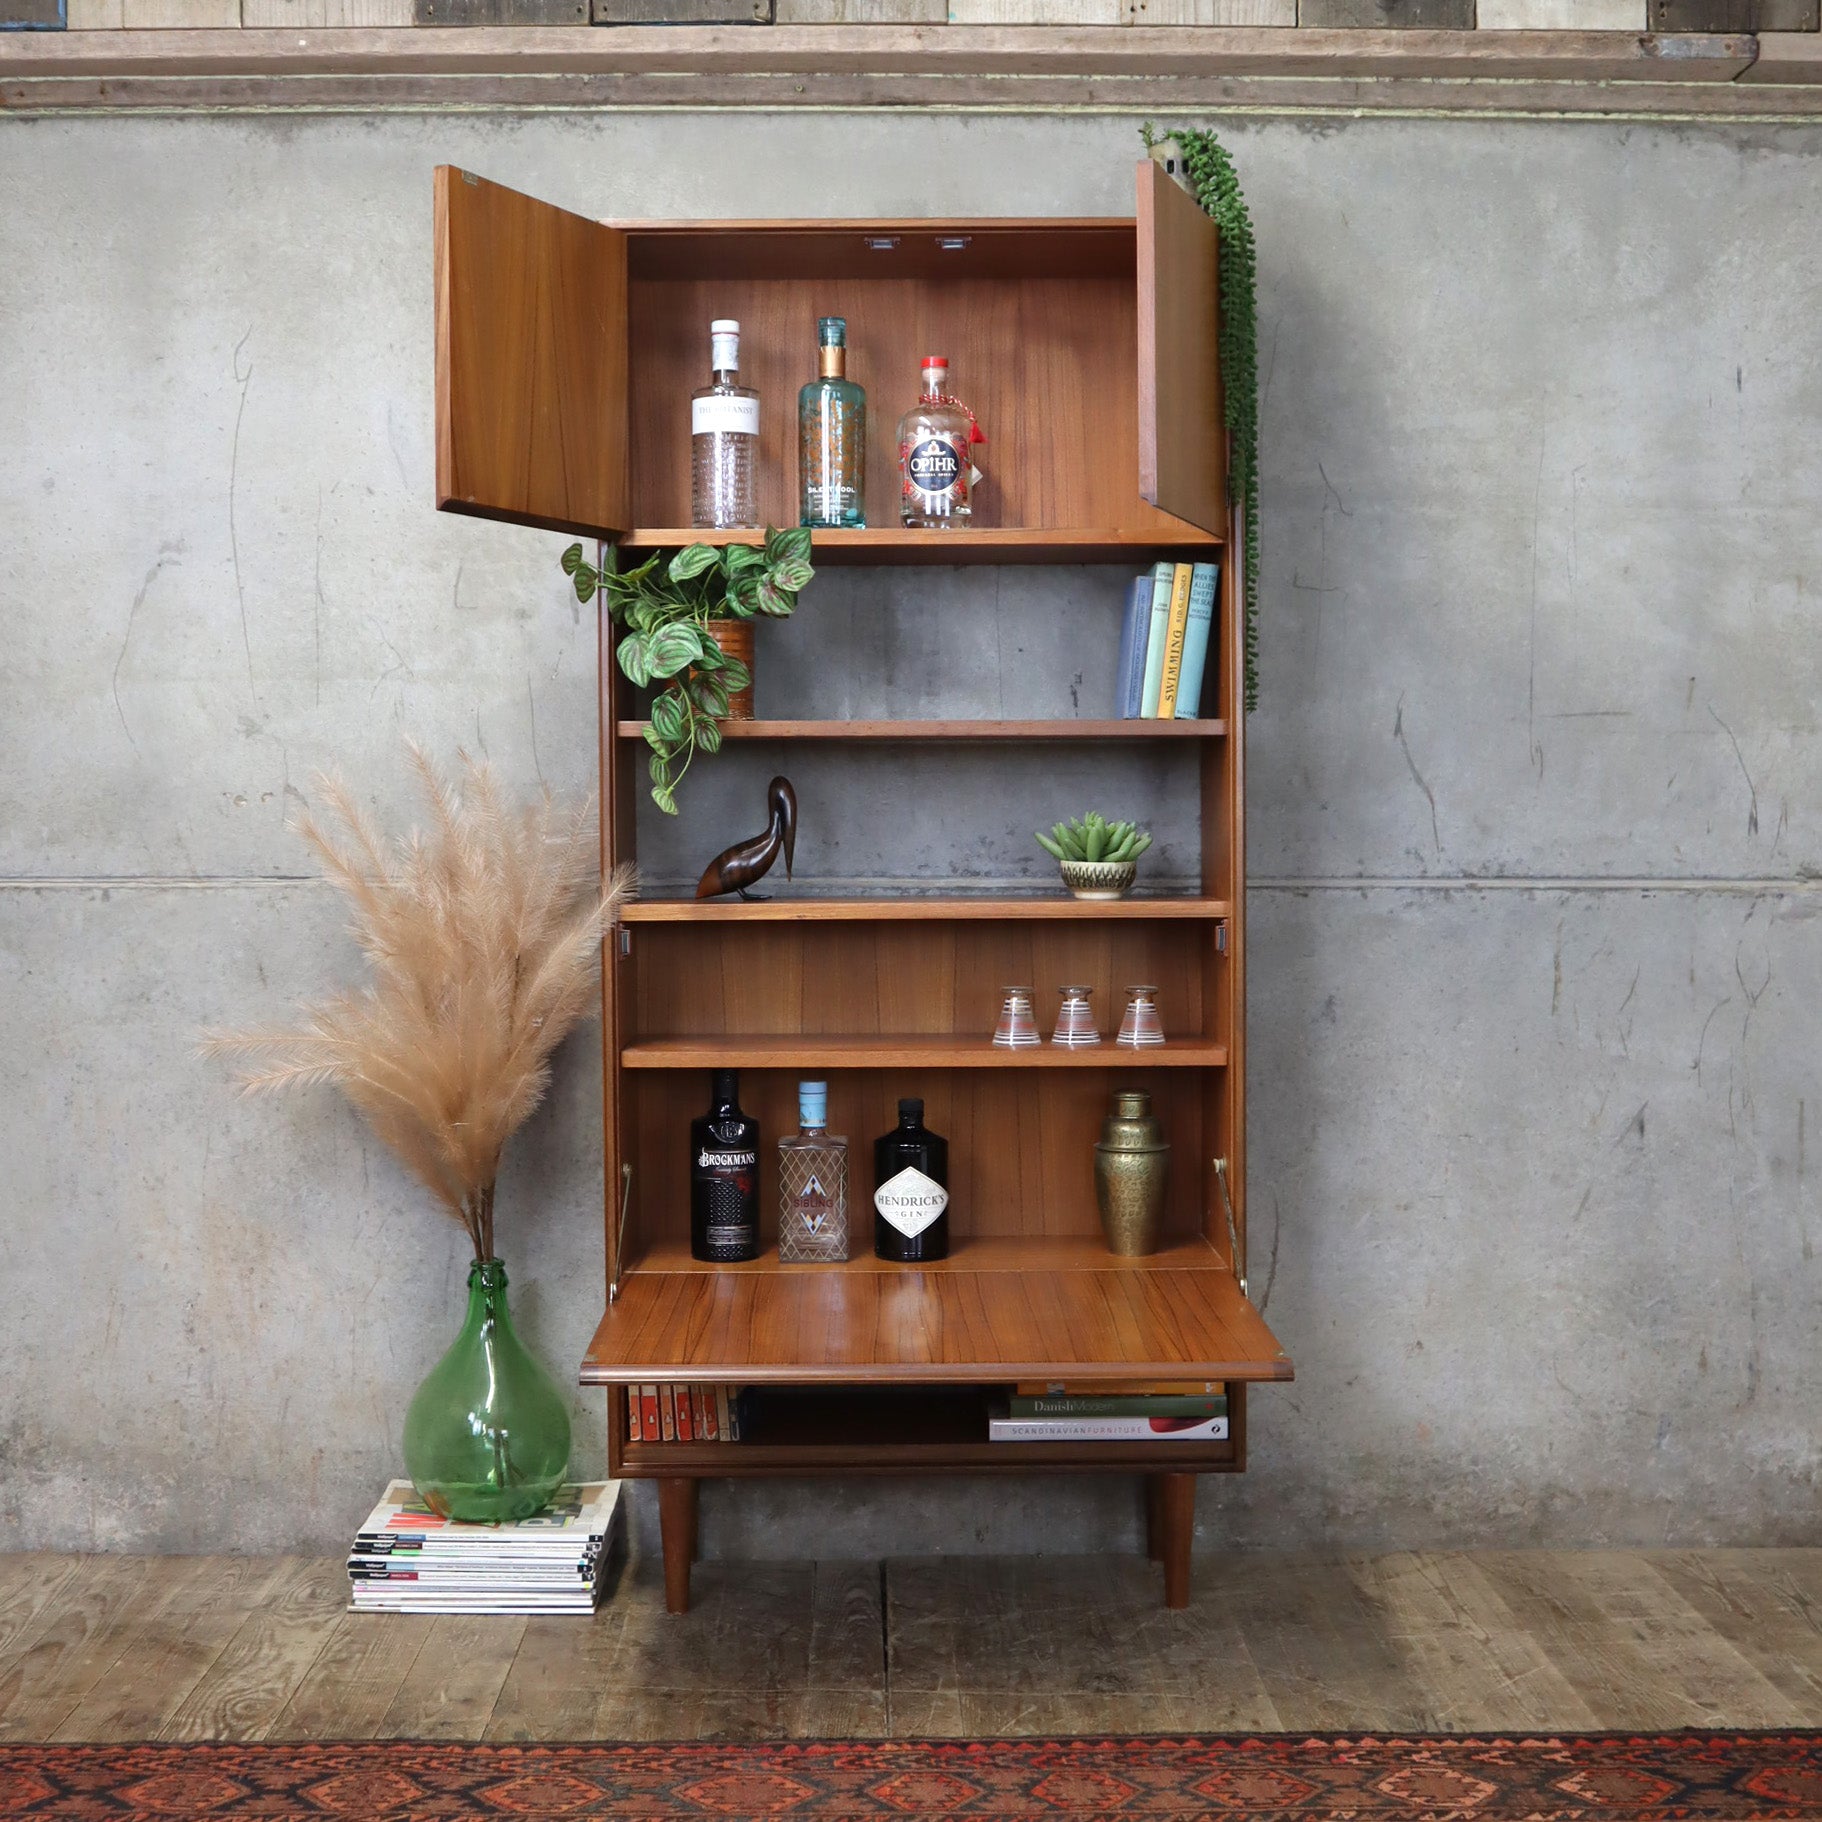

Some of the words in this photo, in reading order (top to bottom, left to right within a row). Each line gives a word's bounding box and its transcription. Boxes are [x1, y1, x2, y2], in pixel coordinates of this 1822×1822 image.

[911, 456, 957, 472] OPIHR
[807, 486, 832, 494] SILET
[1165, 630, 1183, 703] SWIMMING
[700, 1150, 755, 1168] BROCKMANS
[793, 1199, 834, 1208] SIBLING
[878, 1193, 945, 1206] HENDRICK'S
[900, 1210, 923, 1218] GIN
